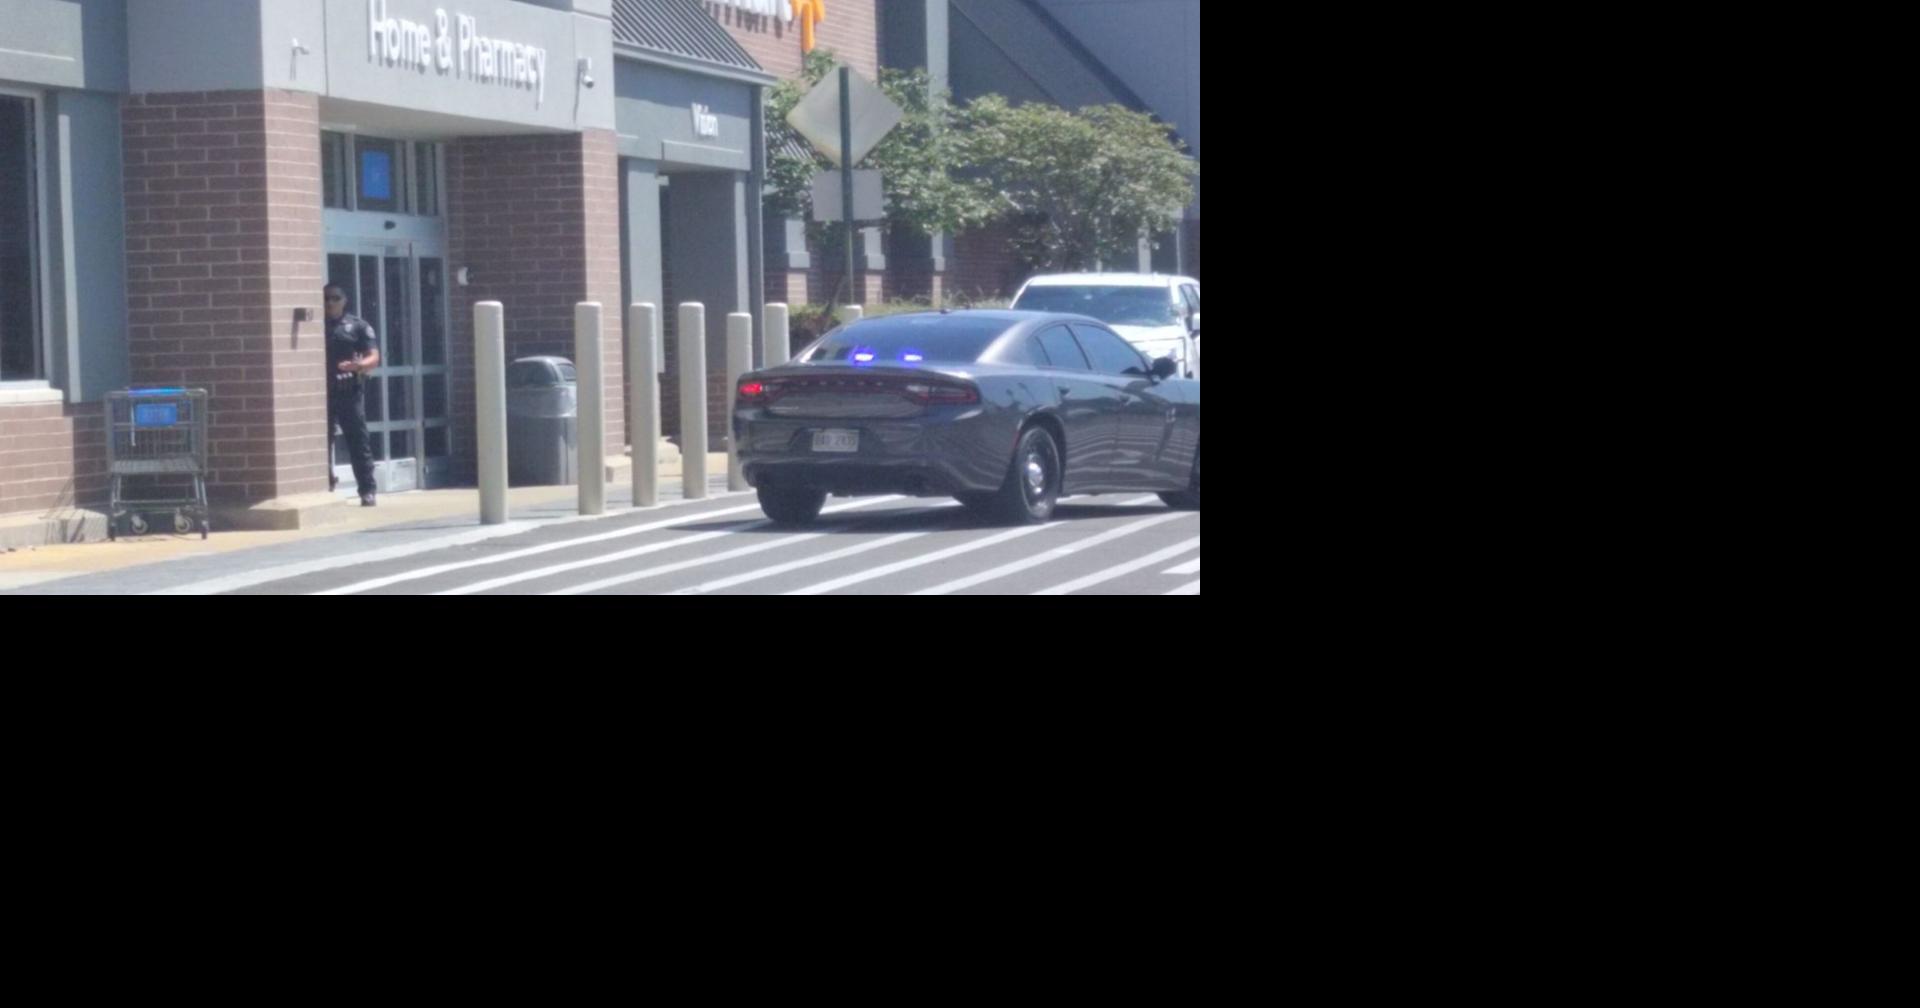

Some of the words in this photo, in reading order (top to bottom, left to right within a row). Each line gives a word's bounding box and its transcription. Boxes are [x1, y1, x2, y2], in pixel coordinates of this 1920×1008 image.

[370, 0, 431, 66] Home
[434, 8, 454, 69] &
[457, 13, 546, 103] Pharmacy
